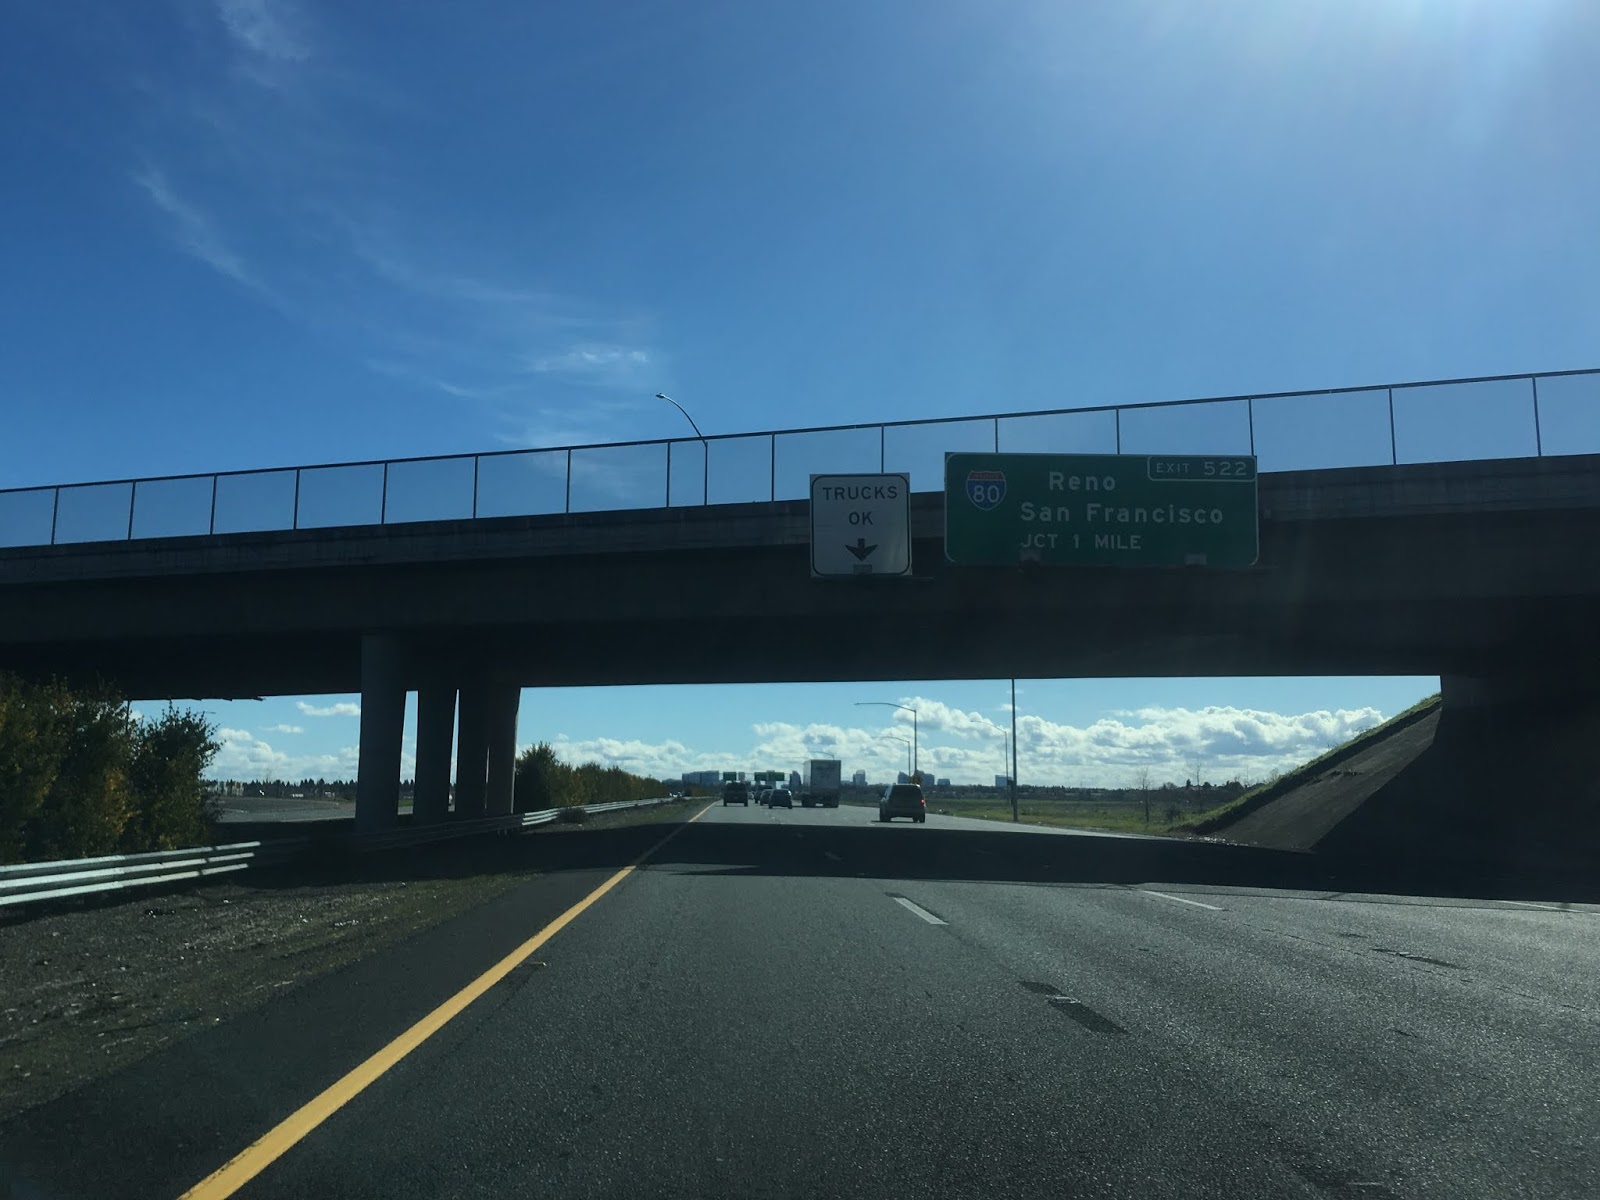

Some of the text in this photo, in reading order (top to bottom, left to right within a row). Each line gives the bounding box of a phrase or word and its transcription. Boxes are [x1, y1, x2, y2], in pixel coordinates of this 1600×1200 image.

[1156, 461, 1247, 476] EXIT 522
[1049, 472, 1116, 491] Reno
[823, 486, 898, 500] TRUCKS
[972, 485, 1000, 503] 80
[849, 511, 873, 525] OK
[1020, 502, 1225, 524] San Francisco
[1020, 534, 1142, 550] JCT 1 MILE
